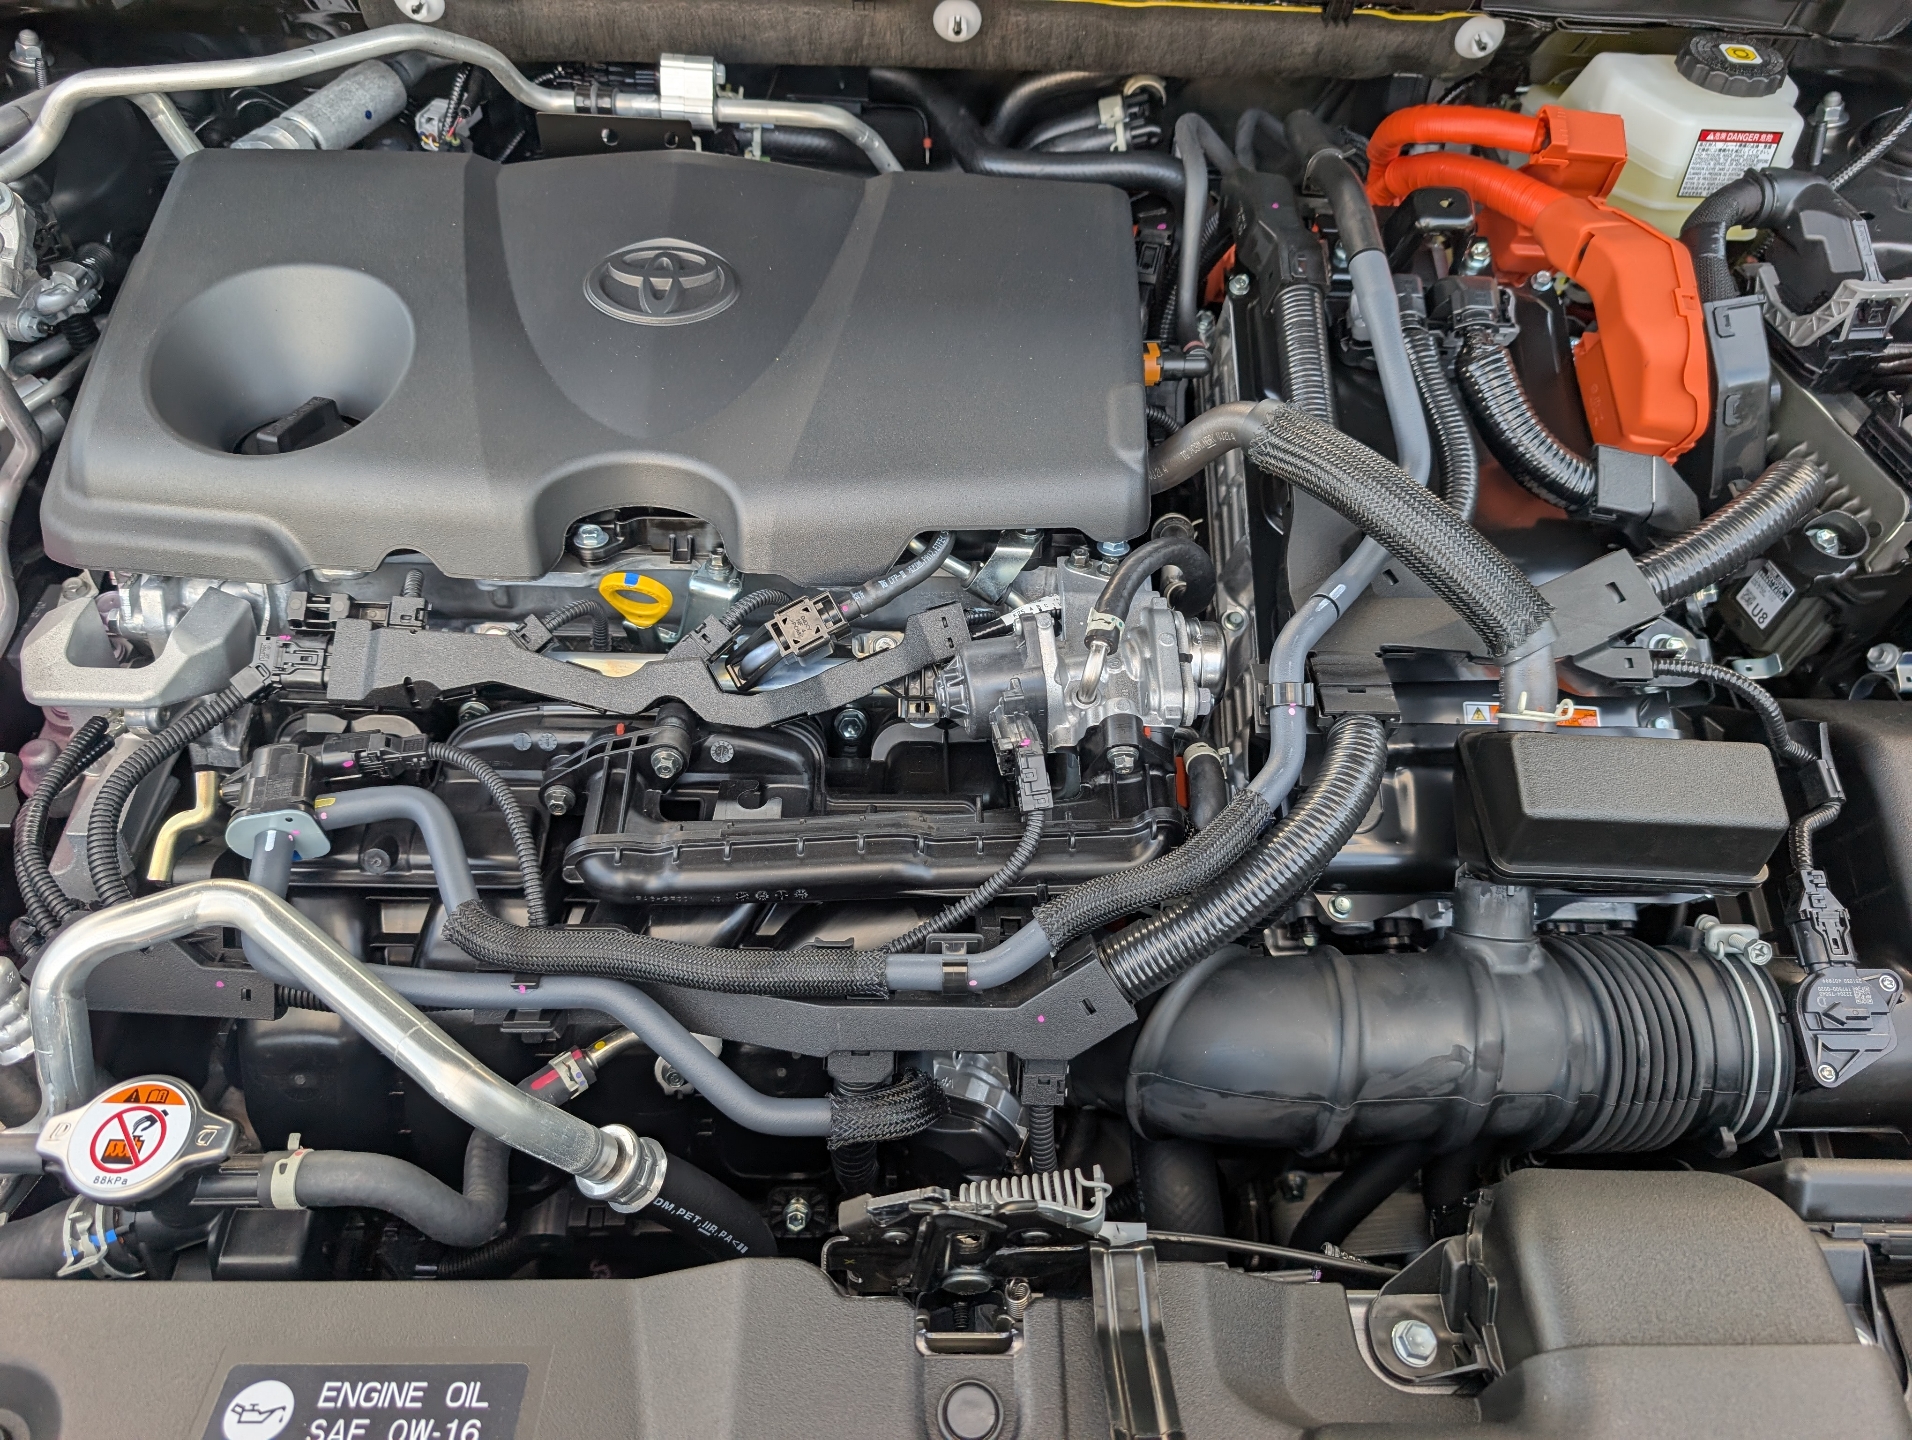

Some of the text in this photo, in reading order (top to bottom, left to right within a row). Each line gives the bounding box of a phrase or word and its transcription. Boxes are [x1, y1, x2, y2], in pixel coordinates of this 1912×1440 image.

[1727, 132, 1760, 141] DANGER
[1751, 603, 1768, 624] U8
[93, 1176, 128, 1185] 88kPa
[317, 1381, 489, 1408] ENGINE OIL
